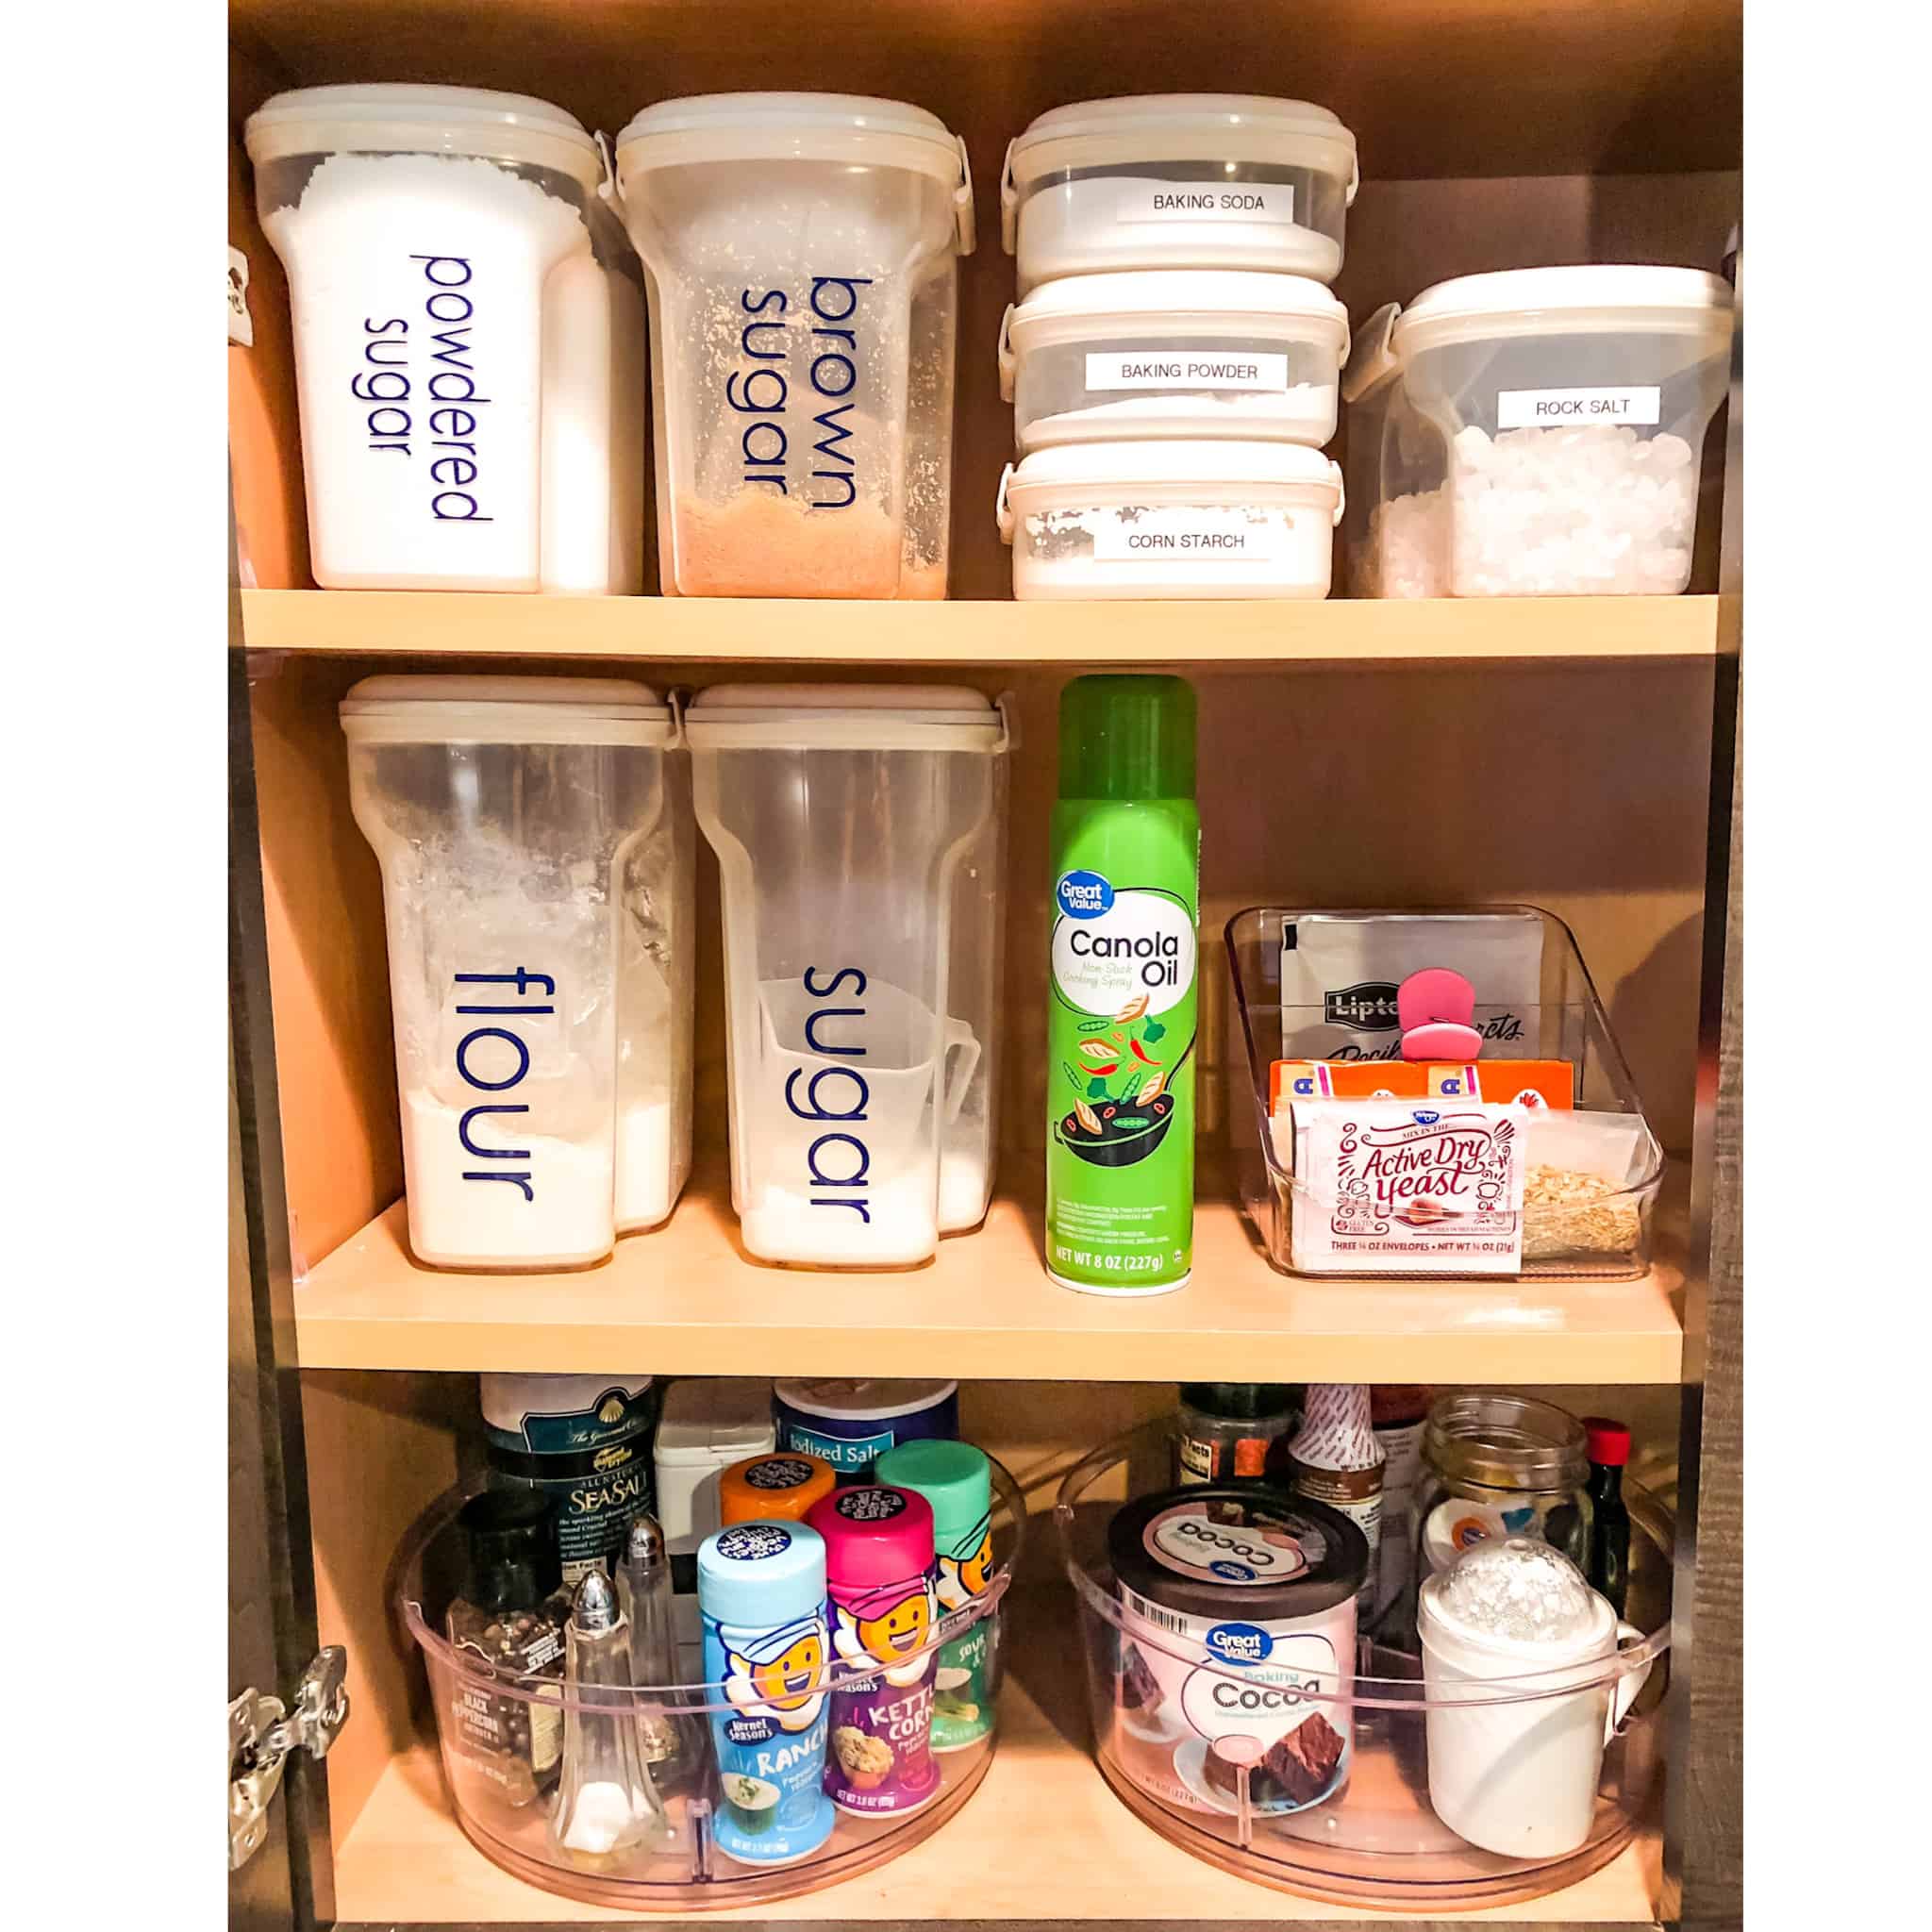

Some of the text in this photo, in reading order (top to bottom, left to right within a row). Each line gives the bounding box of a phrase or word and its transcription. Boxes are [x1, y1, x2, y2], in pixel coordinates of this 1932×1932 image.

[1154, 194, 1265, 209] BAKING SODA
[1122, 364, 1258, 379] BAKING POWDER
[352, 317, 411, 458] sugar
[410, 254, 493, 523] powdered
[726, 289, 788, 496] sugar
[810, 277, 873, 509] brown
[1536, 399, 1631, 416] ROCK SALT
[1128, 534, 1245, 548] CORN STARCH
[1060, 880, 1102, 899] Great
[1069, 897, 1102, 910] Value
[1070, 929, 1178, 958] Canola
[1141, 959, 1177, 987] Oil
[1335, 995, 1399, 1022] Lipto
[455, 965, 555, 1203] flour
[785, 966, 870, 1224] sugar
[1362, 1137, 1487, 1179] Active Dry
[1057, 1245, 1072, 1261] NET
[1074, 1251, 1091, 1268] WT
[1094, 1256, 1102, 1268] 8
[1105, 1256, 1122, 1269] OZ
[1124, 1255, 1163, 1272] (227g)
[1331, 1241, 1357, 1250] THREE
[1382, 1242, 1429, 1251] ENVELOPES
[1438, 1242, 1454, 1251] NET
[1457, 1242, 1471, 1251] WT
[1482, 1242, 1493, 1251] OZ
[791, 1433, 841, 1461] Iodized
[568, 1488, 611, 1515] SEA
[1177, 1522, 1275, 1566] Cocoa
[1212, 1630, 1261, 1648] Great
[1224, 1645, 1261, 1658] Value
[838, 1677, 879, 1692] ason's
[1244, 1671, 1299, 1684] Baking
[868, 1683, 935, 1726] KETTL
[1212, 1679, 1321, 1709] Cocoa
[732, 1718, 768, 1732] Kernel
